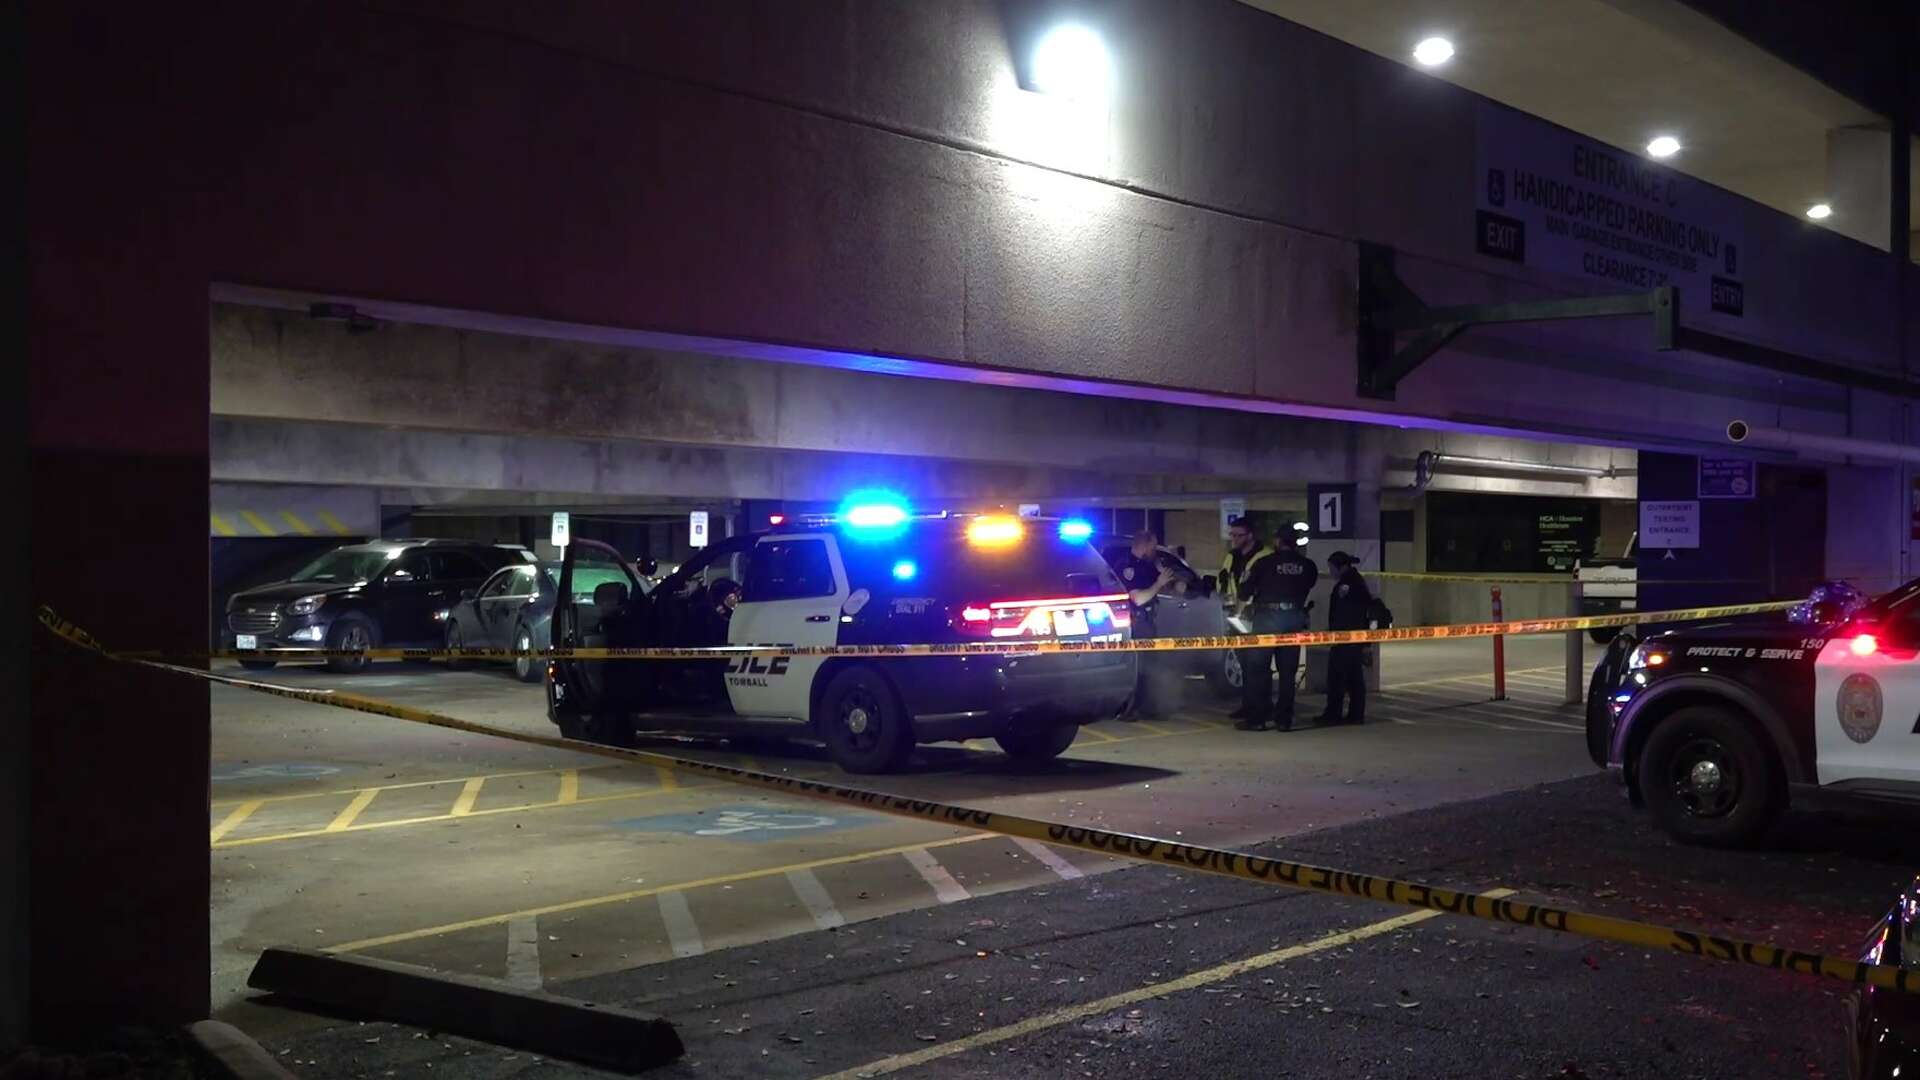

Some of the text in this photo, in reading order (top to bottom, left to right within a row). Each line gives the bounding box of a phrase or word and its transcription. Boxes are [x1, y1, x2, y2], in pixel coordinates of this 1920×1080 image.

[1573, 143, 1663, 203] ENTRANCE
[1513, 168, 1722, 259] HANDICAPPED PARKING ONLY
[1486, 220, 1518, 252] EXIT
[1611, 234, 1655, 262] ENTRANCE
[1583, 251, 1648, 288] CLEARANCE
[1713, 283, 1743, 307] ENTRY
[1324, 496, 1337, 527] 1
[1648, 526, 1689, 534] ENTRANCE
[1686, 646, 1805, 660] PROTECT & SERVE
[1799, 637, 1825, 650] 150
